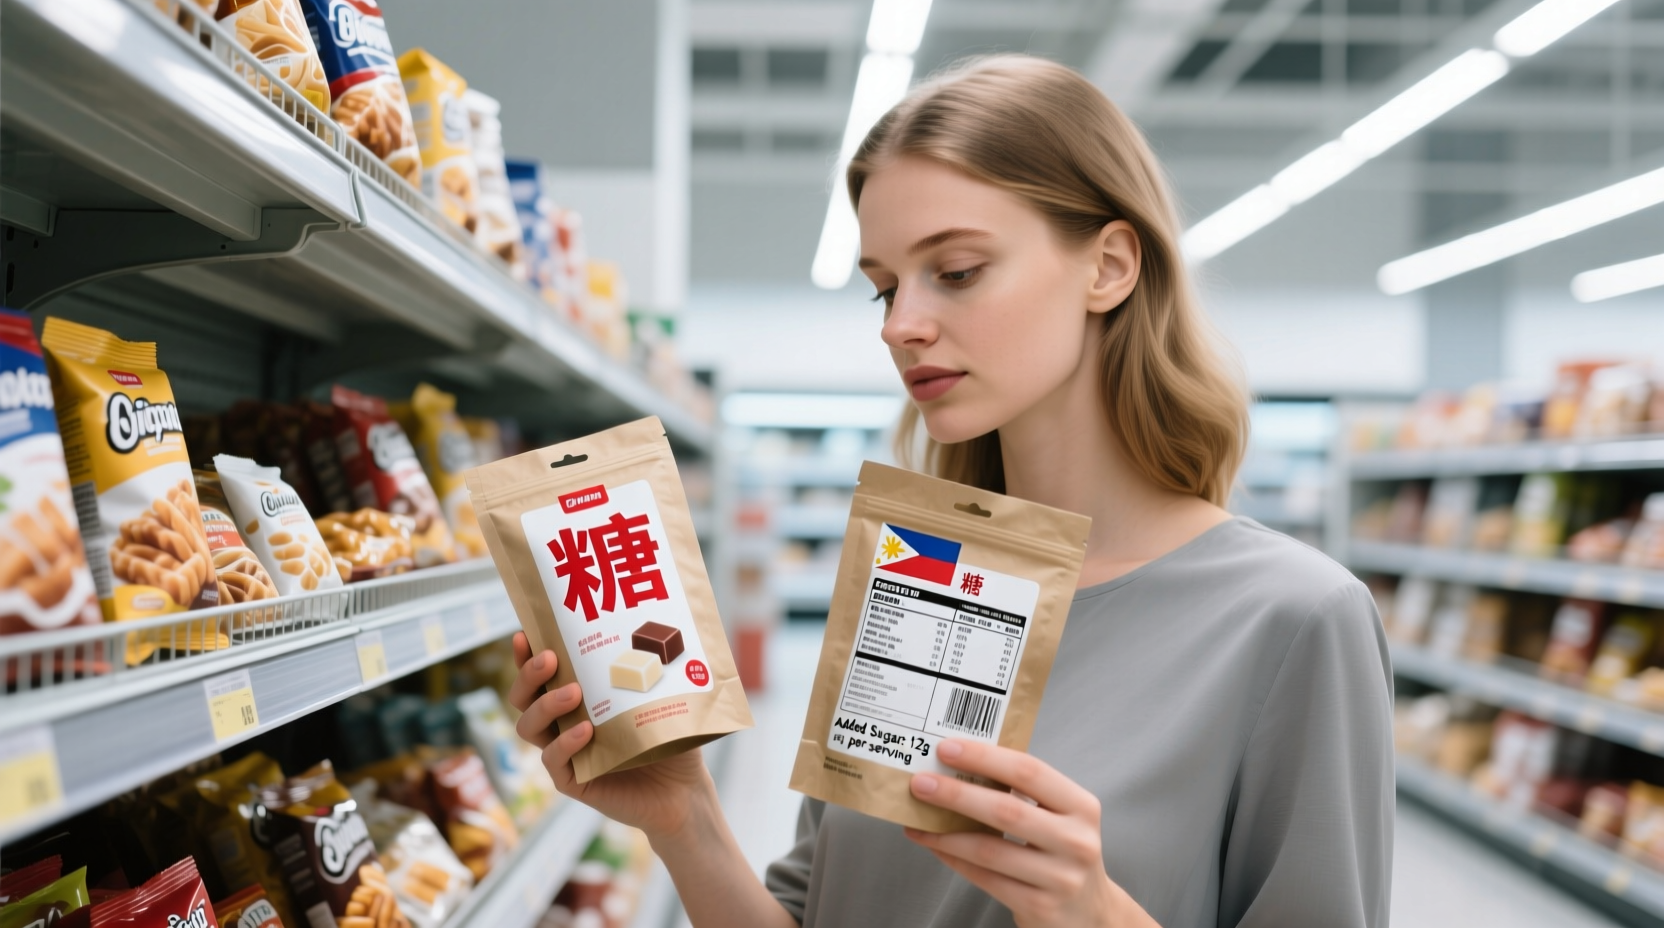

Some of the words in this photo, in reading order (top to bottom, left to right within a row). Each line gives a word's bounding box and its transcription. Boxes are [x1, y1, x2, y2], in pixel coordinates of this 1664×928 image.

[547, 512, 669, 622] 糖
[960, 572, 984, 597] 糖
[834, 717, 867, 734] Added
[870, 725, 906, 745] Sugar:
[910, 736, 930, 756] 12g
[847, 737, 867, 749] per
[868, 743, 912, 765] serving
